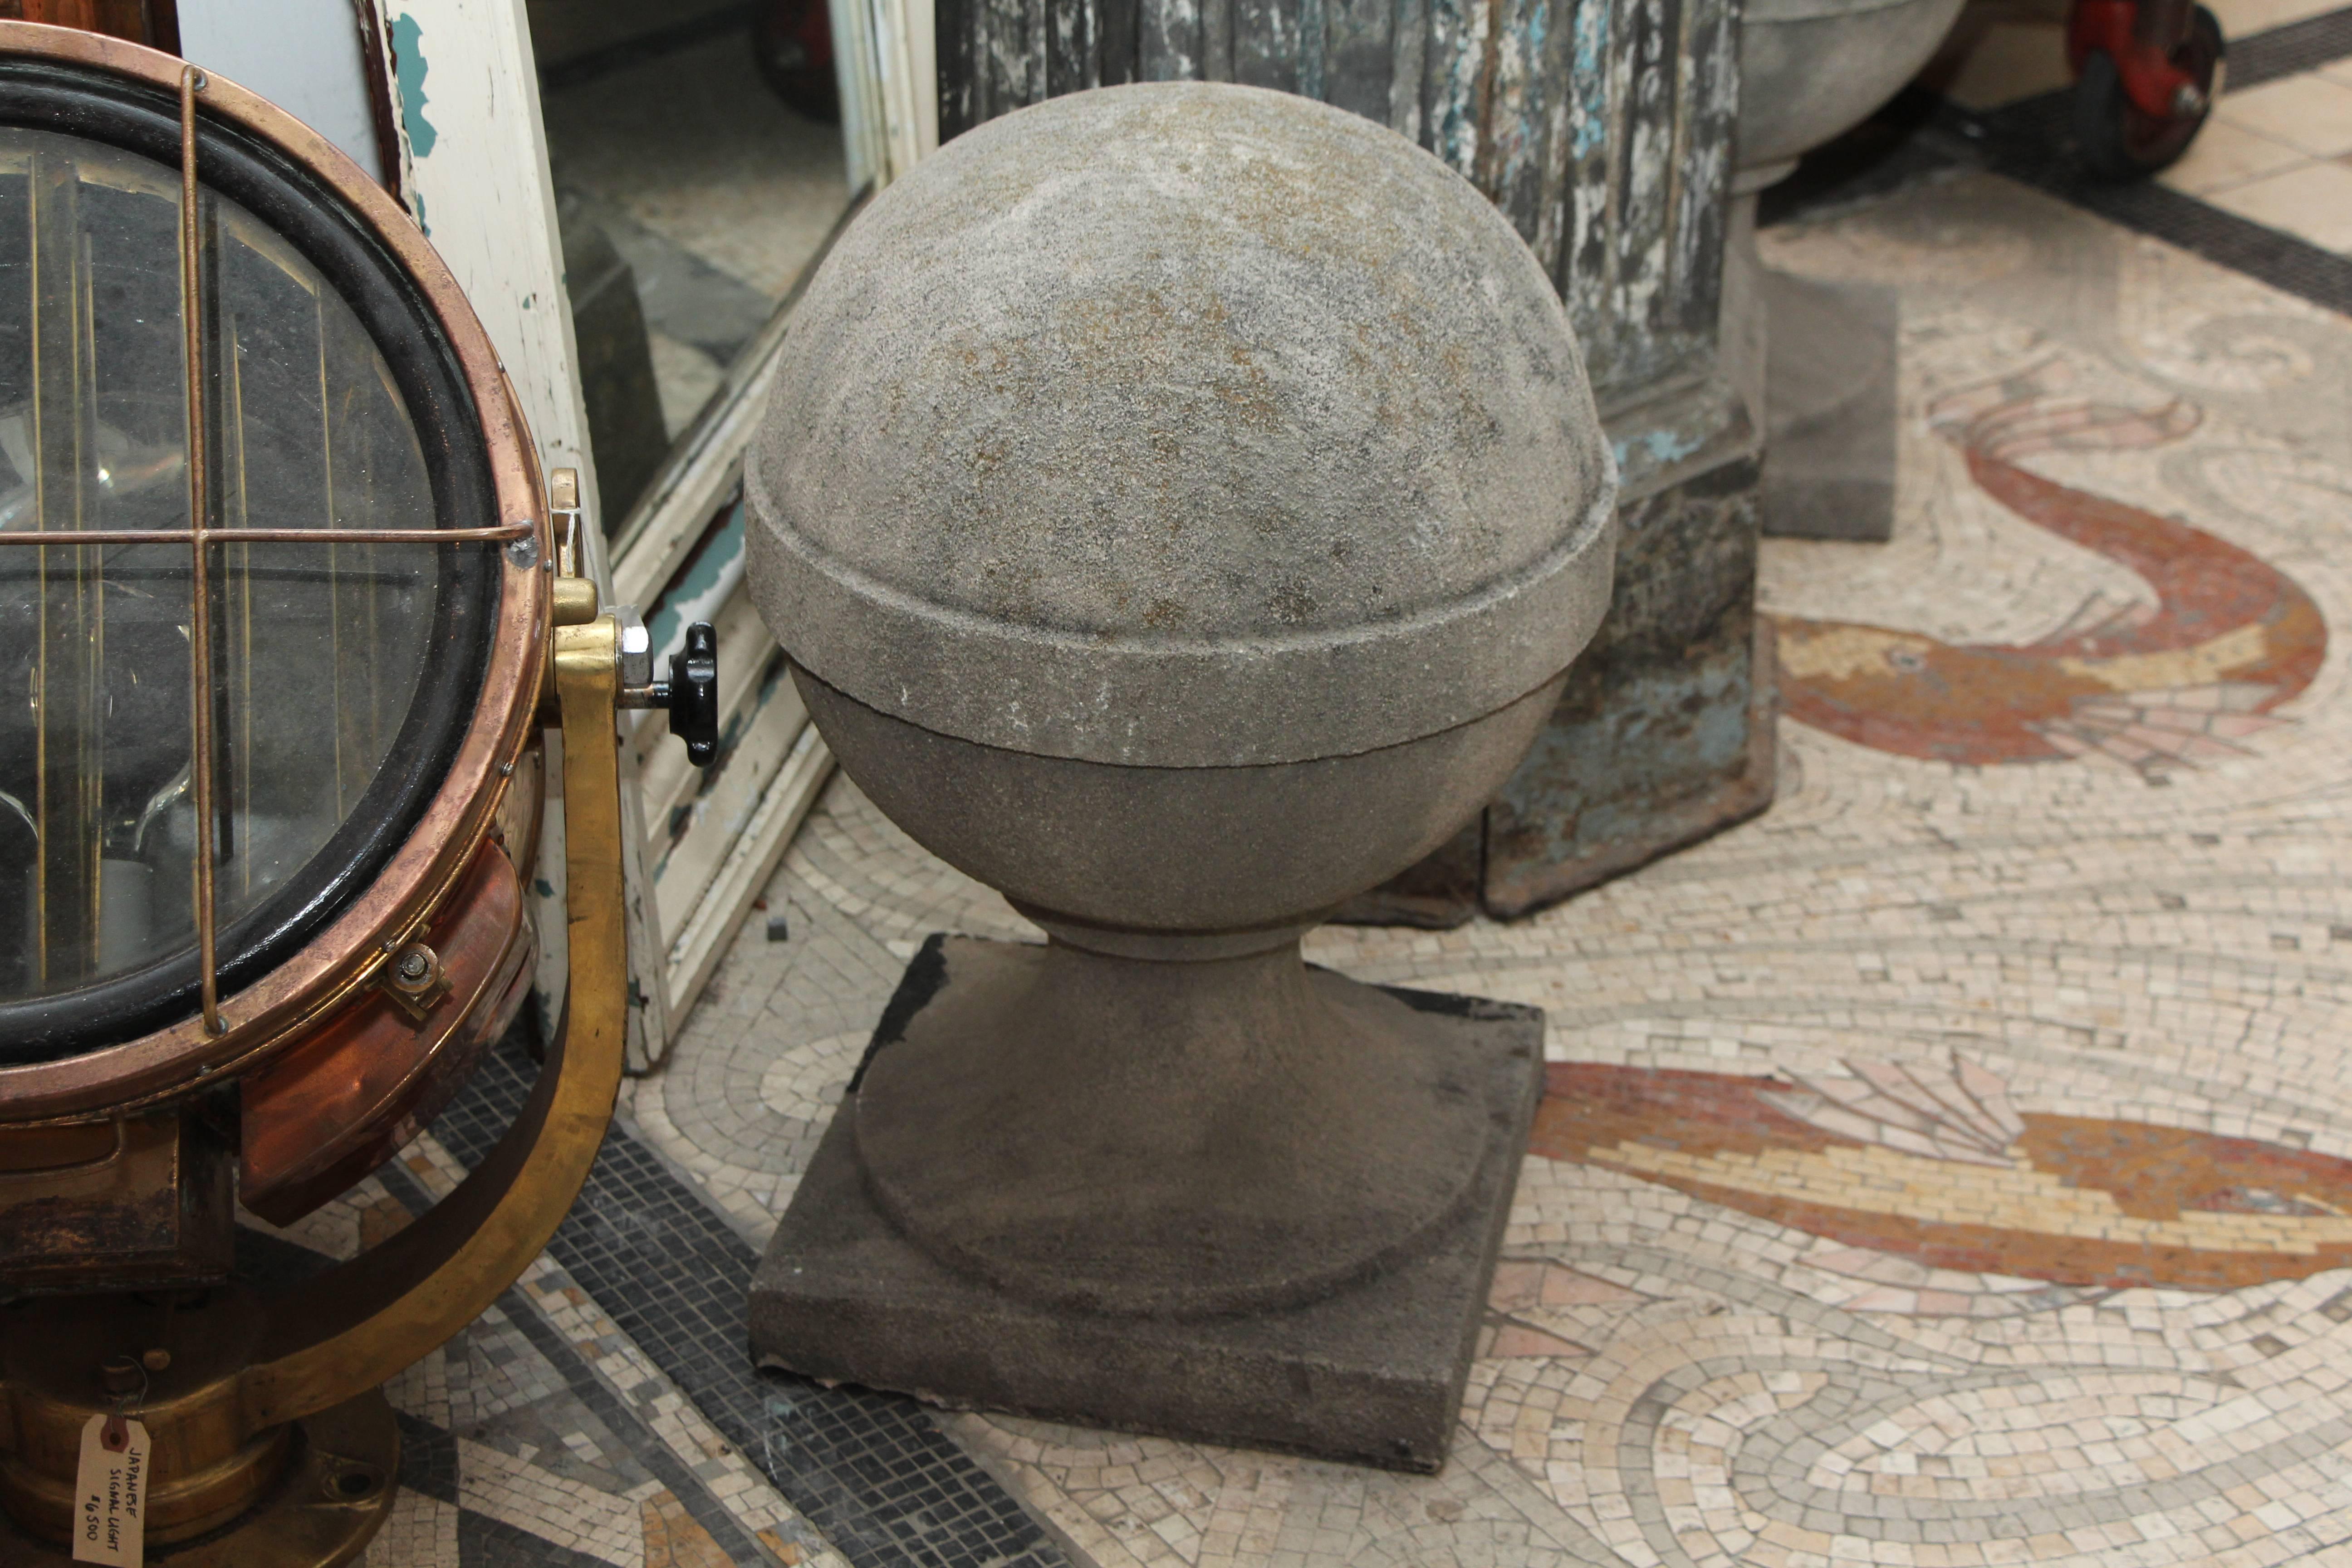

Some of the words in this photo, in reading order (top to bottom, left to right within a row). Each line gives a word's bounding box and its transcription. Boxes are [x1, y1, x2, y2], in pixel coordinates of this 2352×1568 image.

[108, 1468, 122, 1514] SIGNAL
[126, 1446, 142, 1519] JAPANESE
[108, 1517, 120, 1552] LIGHT
